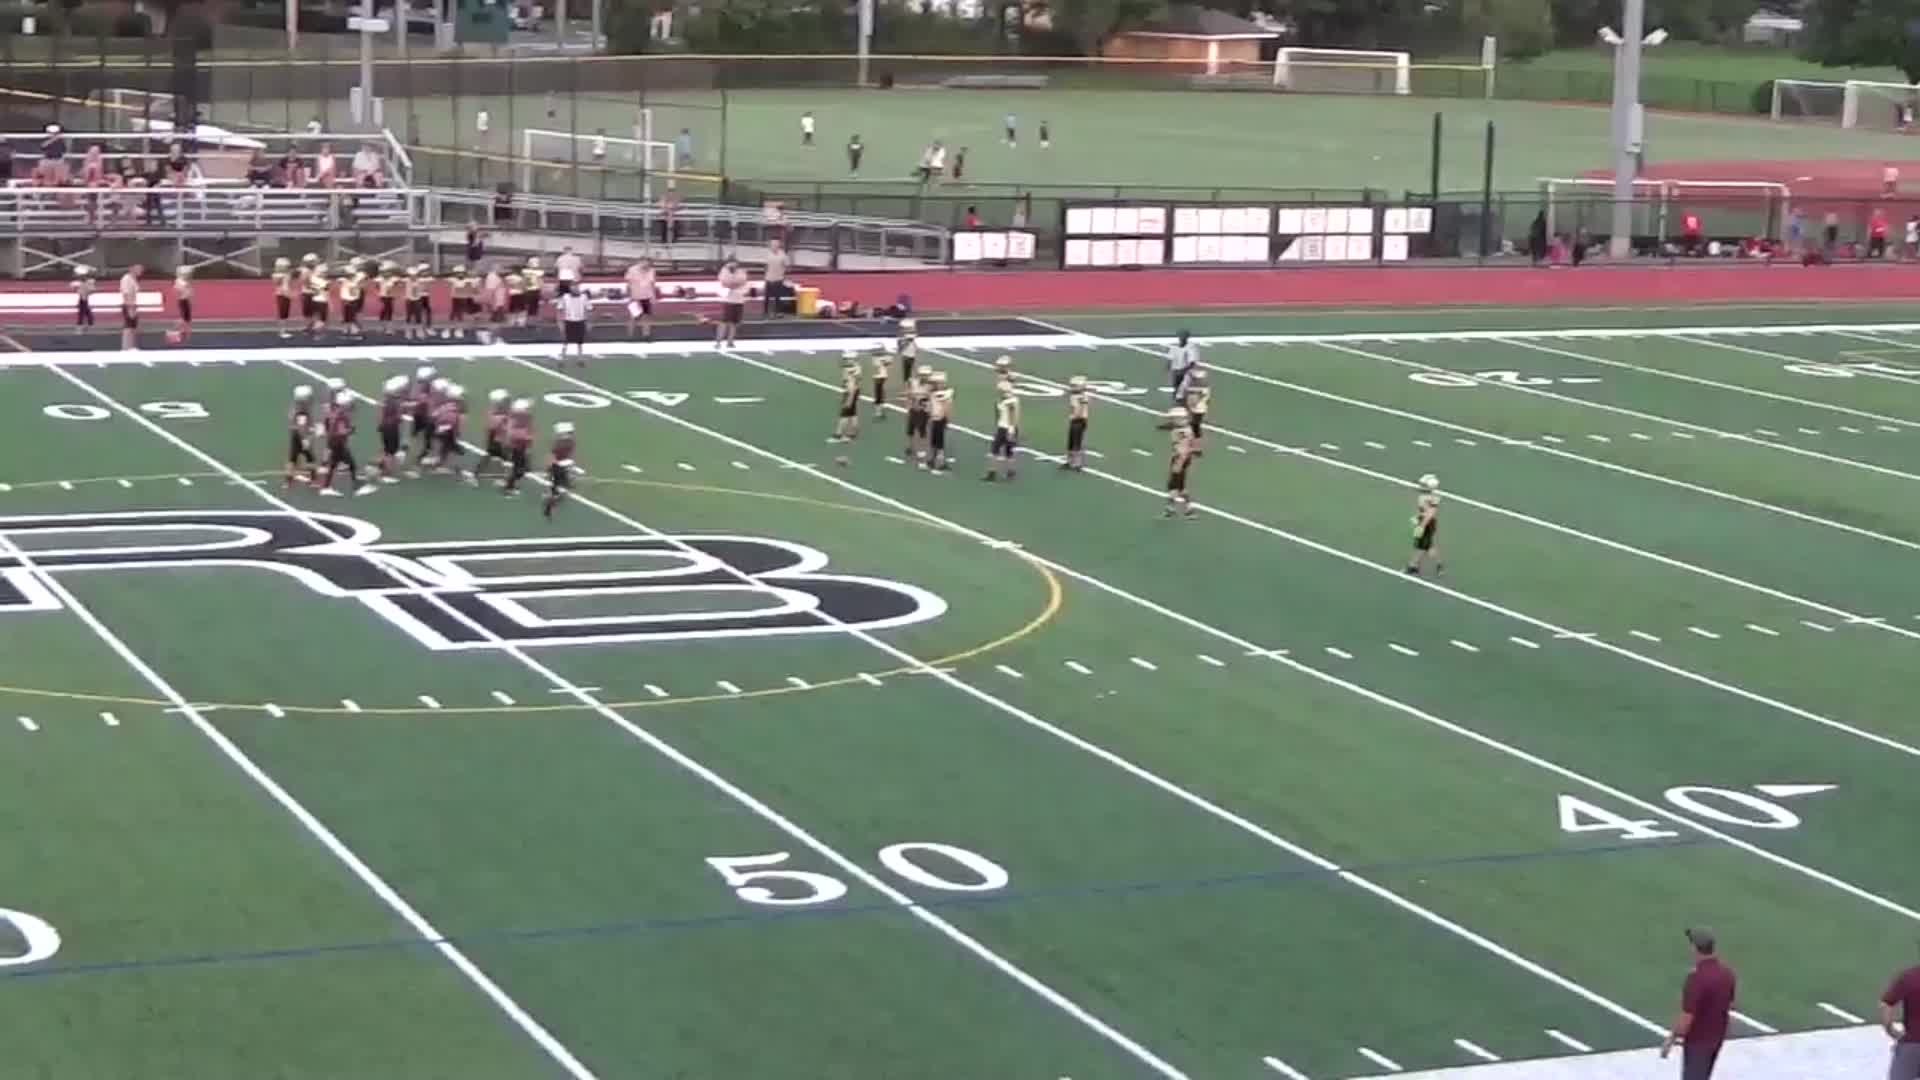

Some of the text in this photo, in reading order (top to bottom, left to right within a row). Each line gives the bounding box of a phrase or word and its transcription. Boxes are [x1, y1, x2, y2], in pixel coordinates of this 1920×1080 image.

[43, 401, 210, 420] 50
[1558, 786, 1801, 839] 40
[704, 842, 1010, 905] 50
